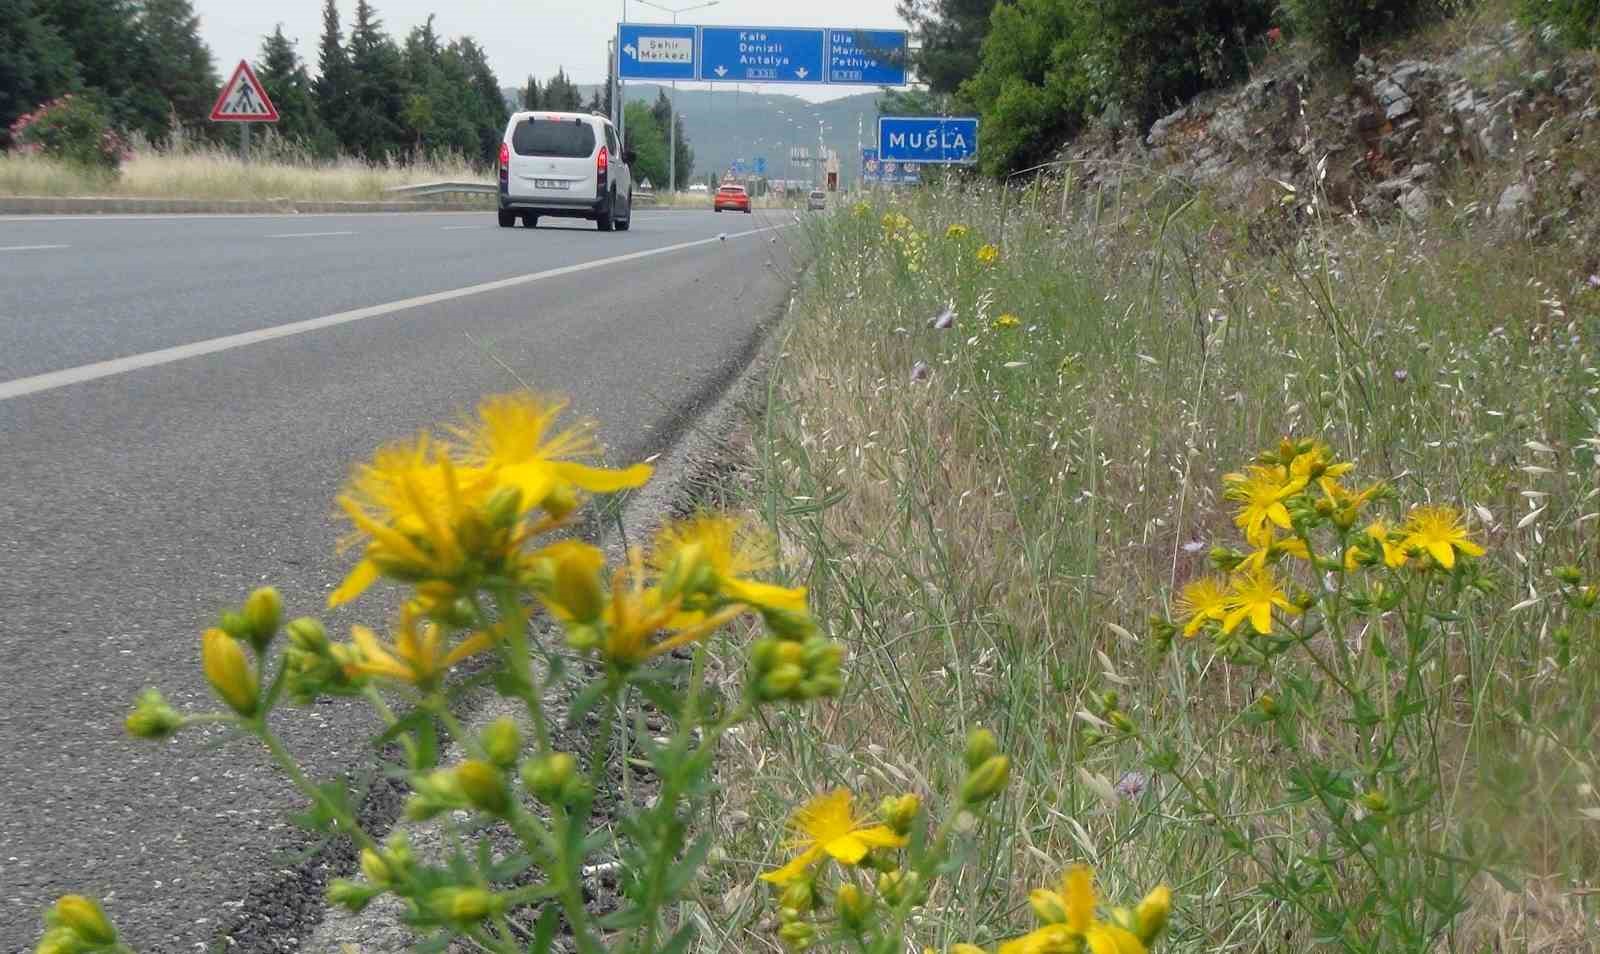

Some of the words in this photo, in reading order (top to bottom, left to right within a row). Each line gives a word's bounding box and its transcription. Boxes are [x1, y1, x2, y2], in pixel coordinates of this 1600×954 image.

[739, 31, 768, 41] Kale
[832, 33, 852, 43] Ula
[739, 42, 783, 53] Denizli
[640, 50, 689, 60] Merkezi
[739, 54, 790, 66] Antalya
[832, 57, 877, 69] Fethiye
[889, 128, 967, 149] MUĞLA
